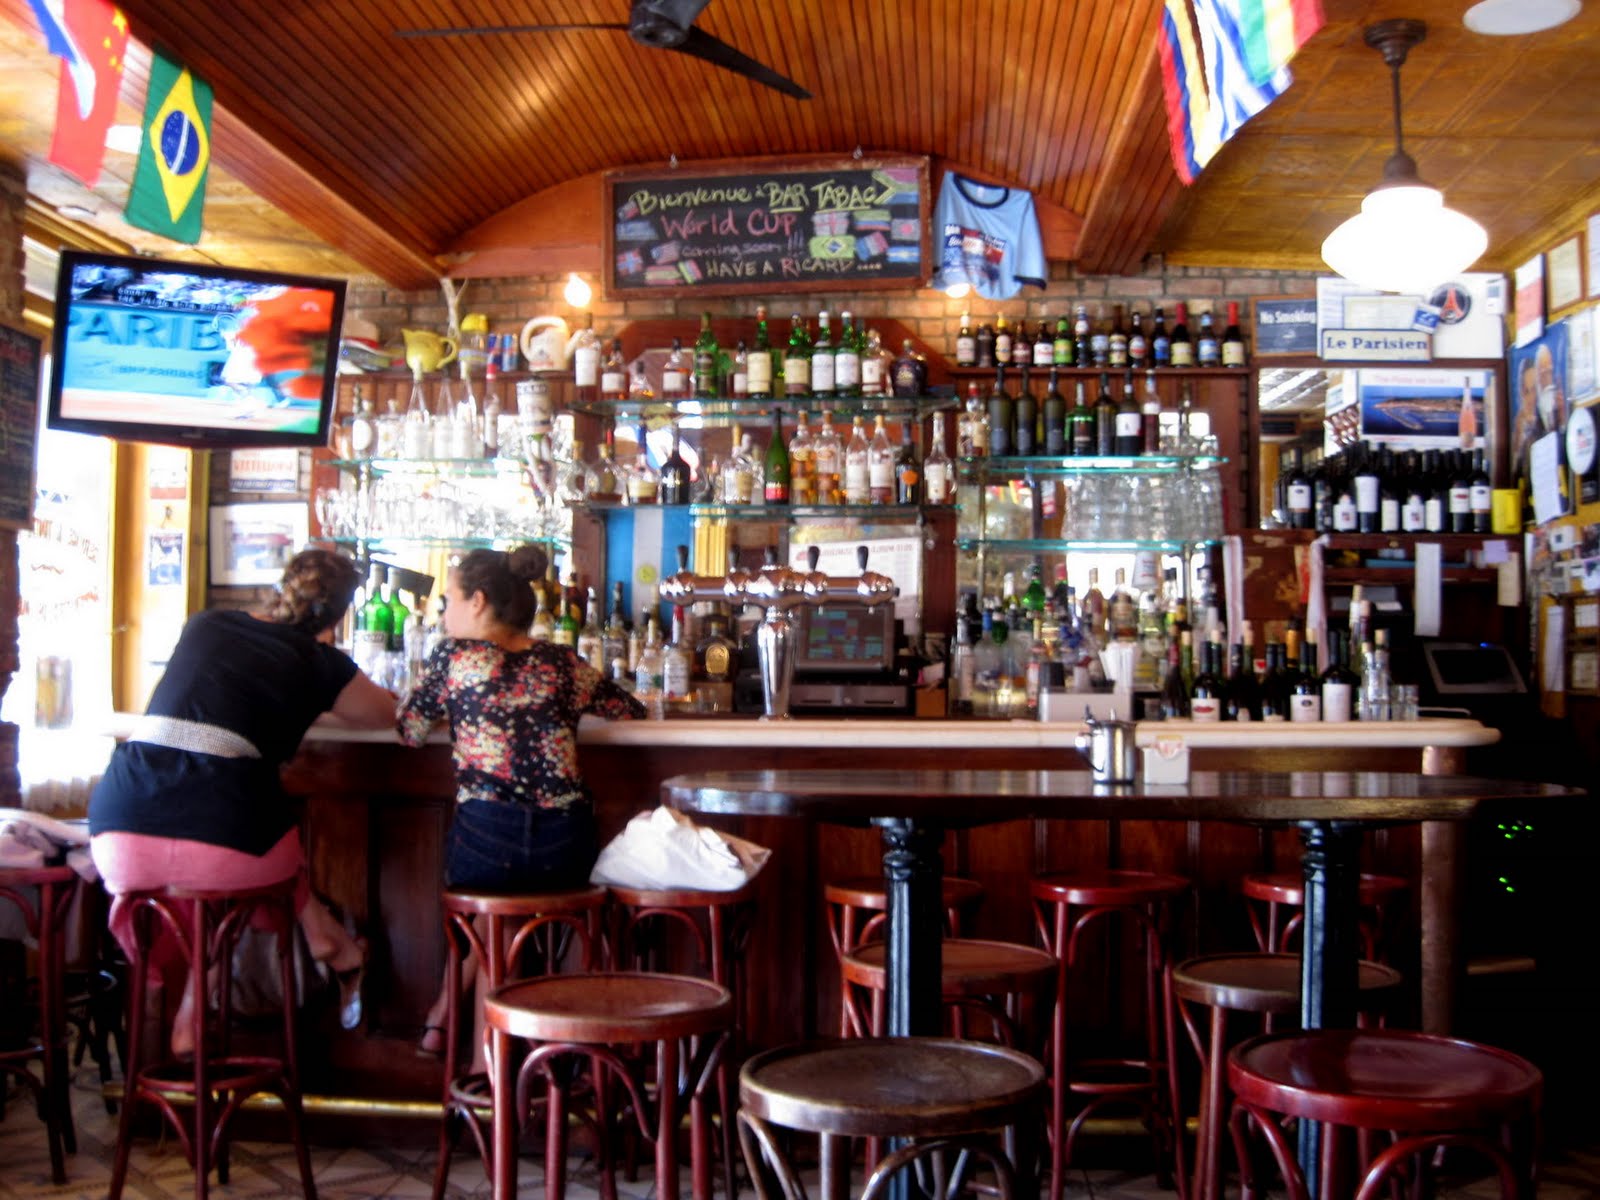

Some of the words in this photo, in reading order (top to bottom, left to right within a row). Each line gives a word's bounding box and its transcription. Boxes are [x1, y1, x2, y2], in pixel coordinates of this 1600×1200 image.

[629, 187, 752, 215] Bienvenue
[764, 181, 809, 208] BAR
[811, 179, 876, 209] TABAC
[660, 209, 740, 239] World
[706, 260, 757, 277] HAVE
[762, 260, 774, 275] A
[781, 257, 853, 277] RICARD
[1326, 337, 1346, 349] Le
[1352, 336, 1427, 349] Parisien
